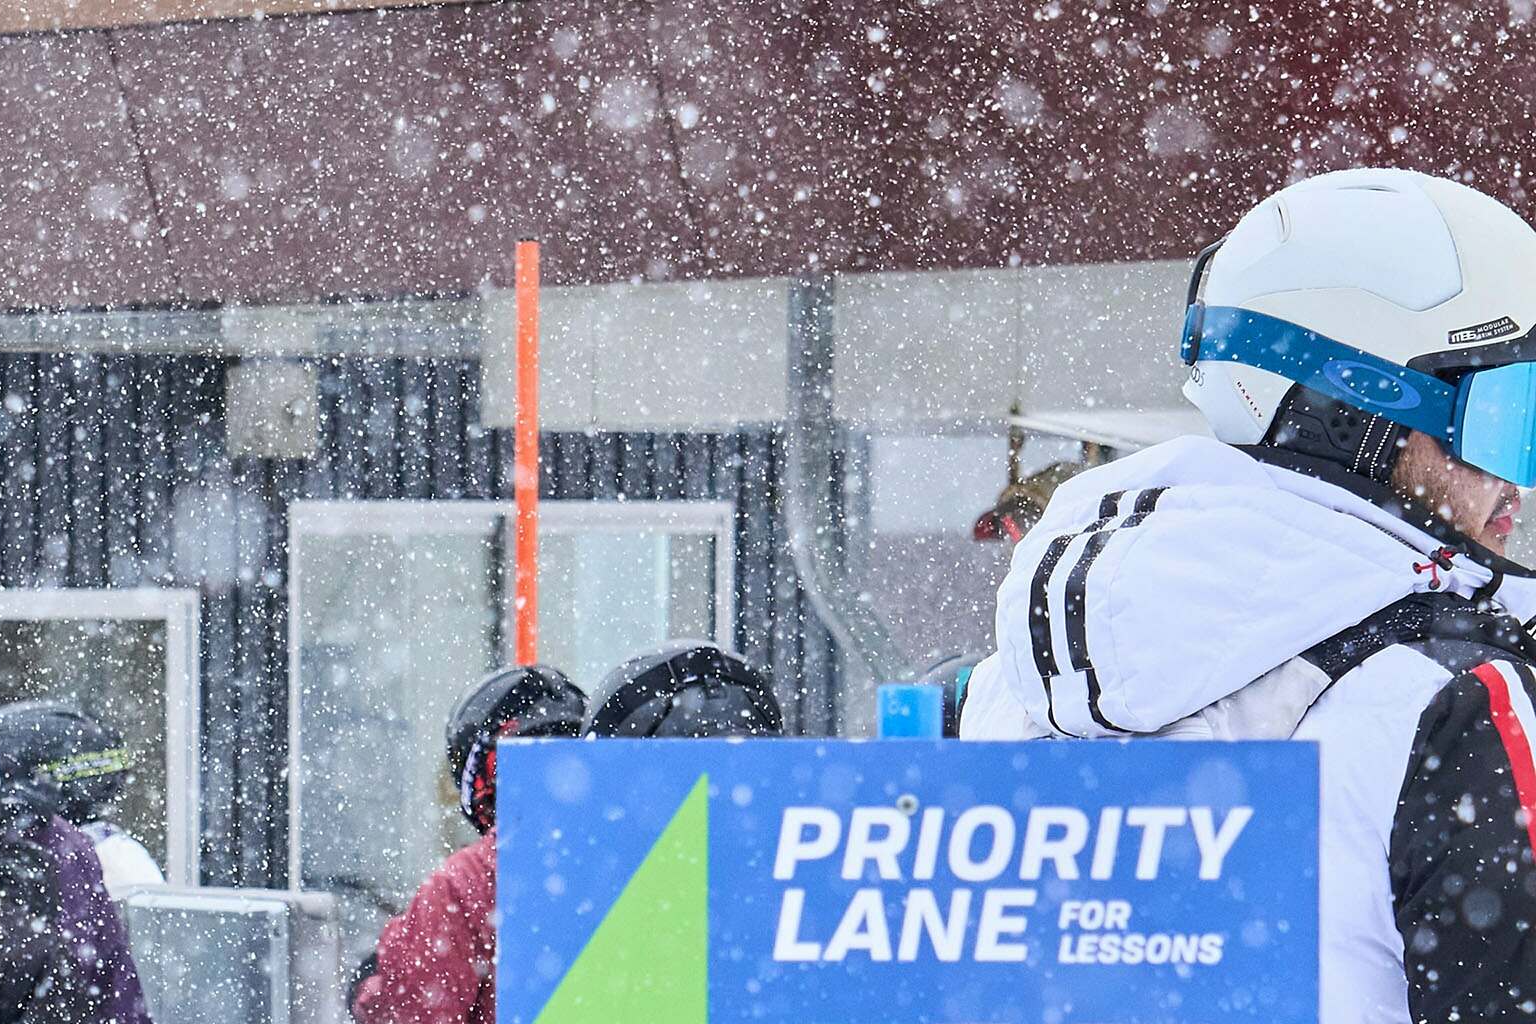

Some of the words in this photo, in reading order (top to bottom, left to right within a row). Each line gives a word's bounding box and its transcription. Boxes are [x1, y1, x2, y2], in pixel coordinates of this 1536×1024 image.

[773, 806, 1253, 882] PRIORITY
[773, 888, 1037, 962] LANE
[1058, 900, 1131, 930] FOR
[1058, 934, 1224, 965] LESSONS
